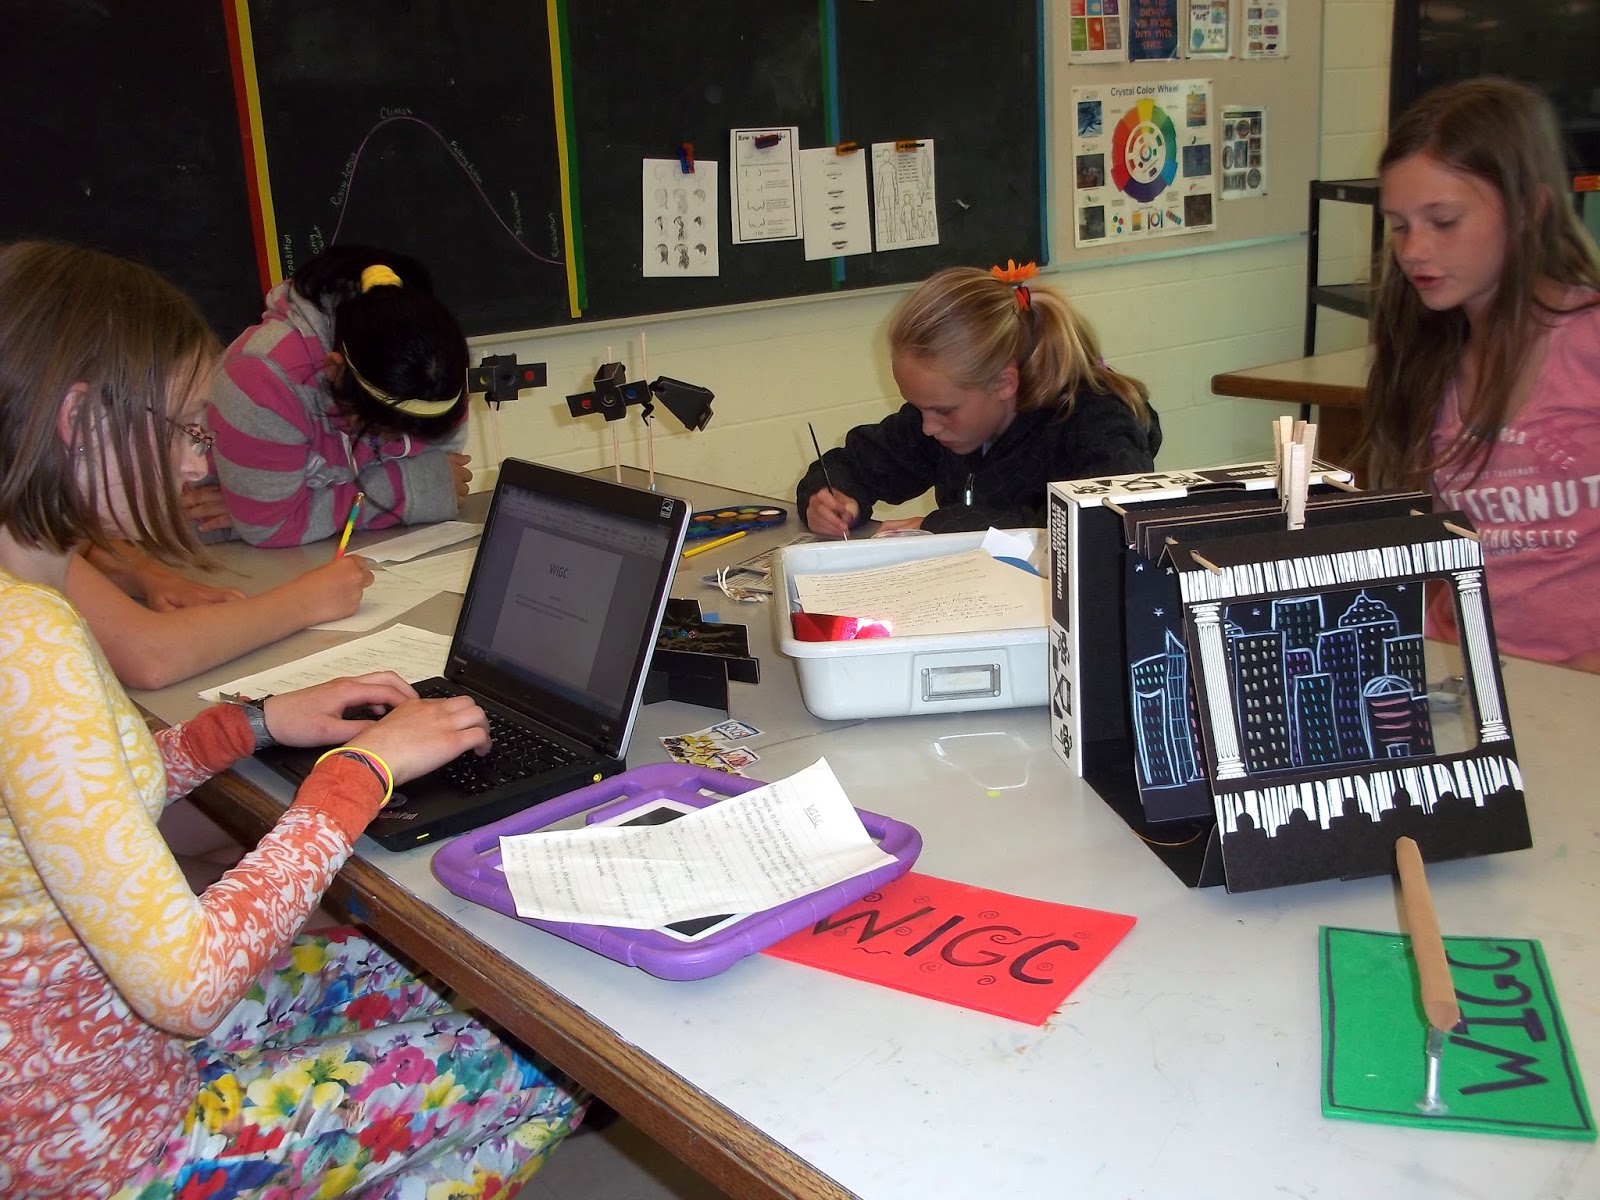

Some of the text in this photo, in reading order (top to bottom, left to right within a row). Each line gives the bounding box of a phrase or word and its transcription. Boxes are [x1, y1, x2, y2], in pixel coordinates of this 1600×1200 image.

[1155, 30, 1172, 38] THIS
[1110, 83, 1179, 98] Crystal Color Wheel
[1440, 474, 1600, 524] TTERNUT
[1479, 528, 1578, 549] CHUSETTS
[549, 563, 569, 579] WIGC
[812, 905, 1081, 986] WIGC
[1445, 945, 1550, 1096] WIGC
